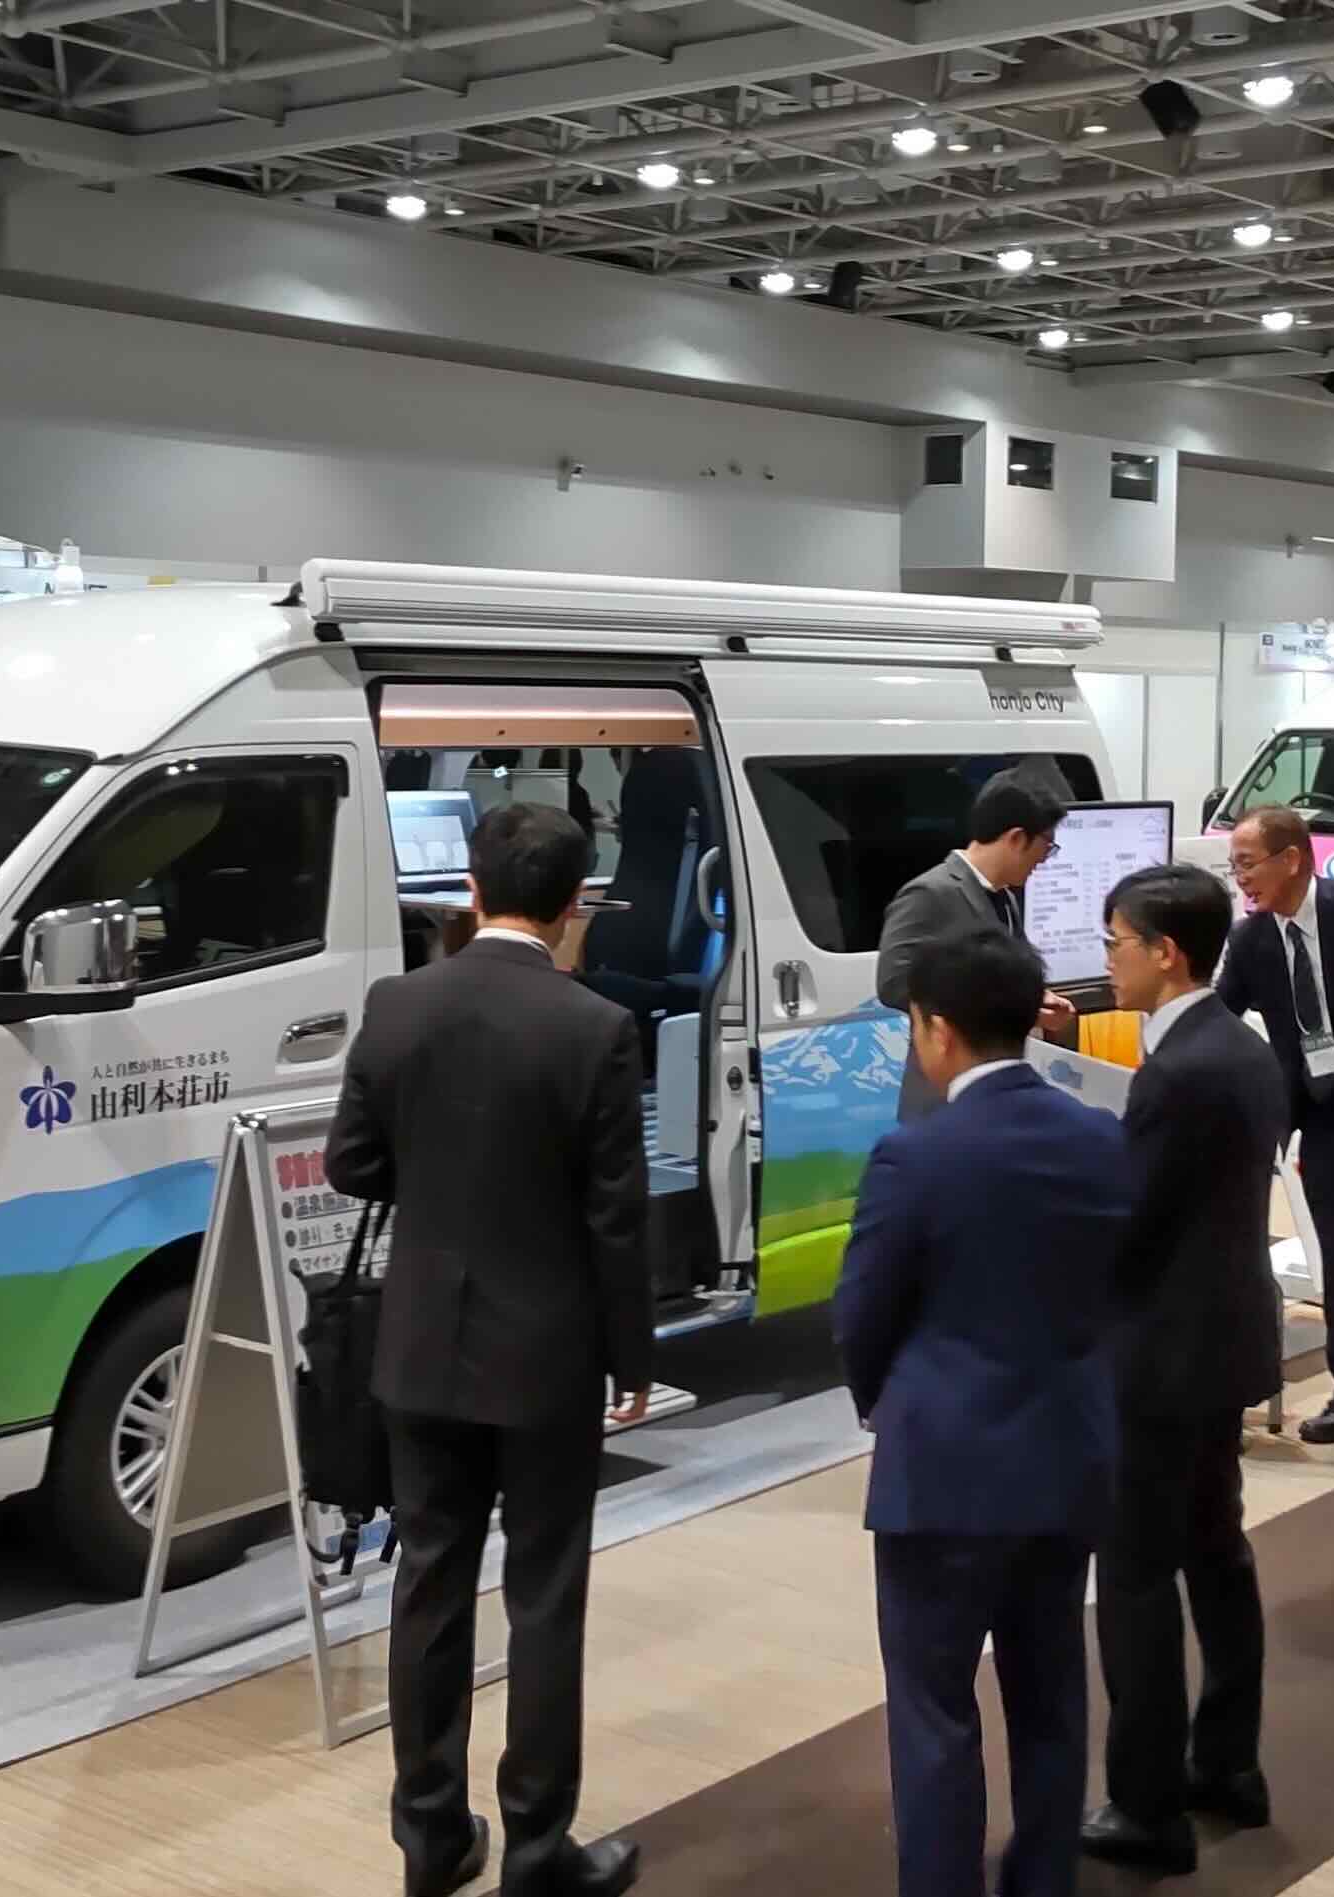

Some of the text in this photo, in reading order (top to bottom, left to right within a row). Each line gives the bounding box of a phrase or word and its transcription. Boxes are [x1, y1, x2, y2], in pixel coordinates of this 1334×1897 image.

[1034, 690, 1065, 713] City
[91, 1049, 231, 1080] 人と自然が共に生きるまち
[90, 1070, 231, 1123] 由利本荘市
